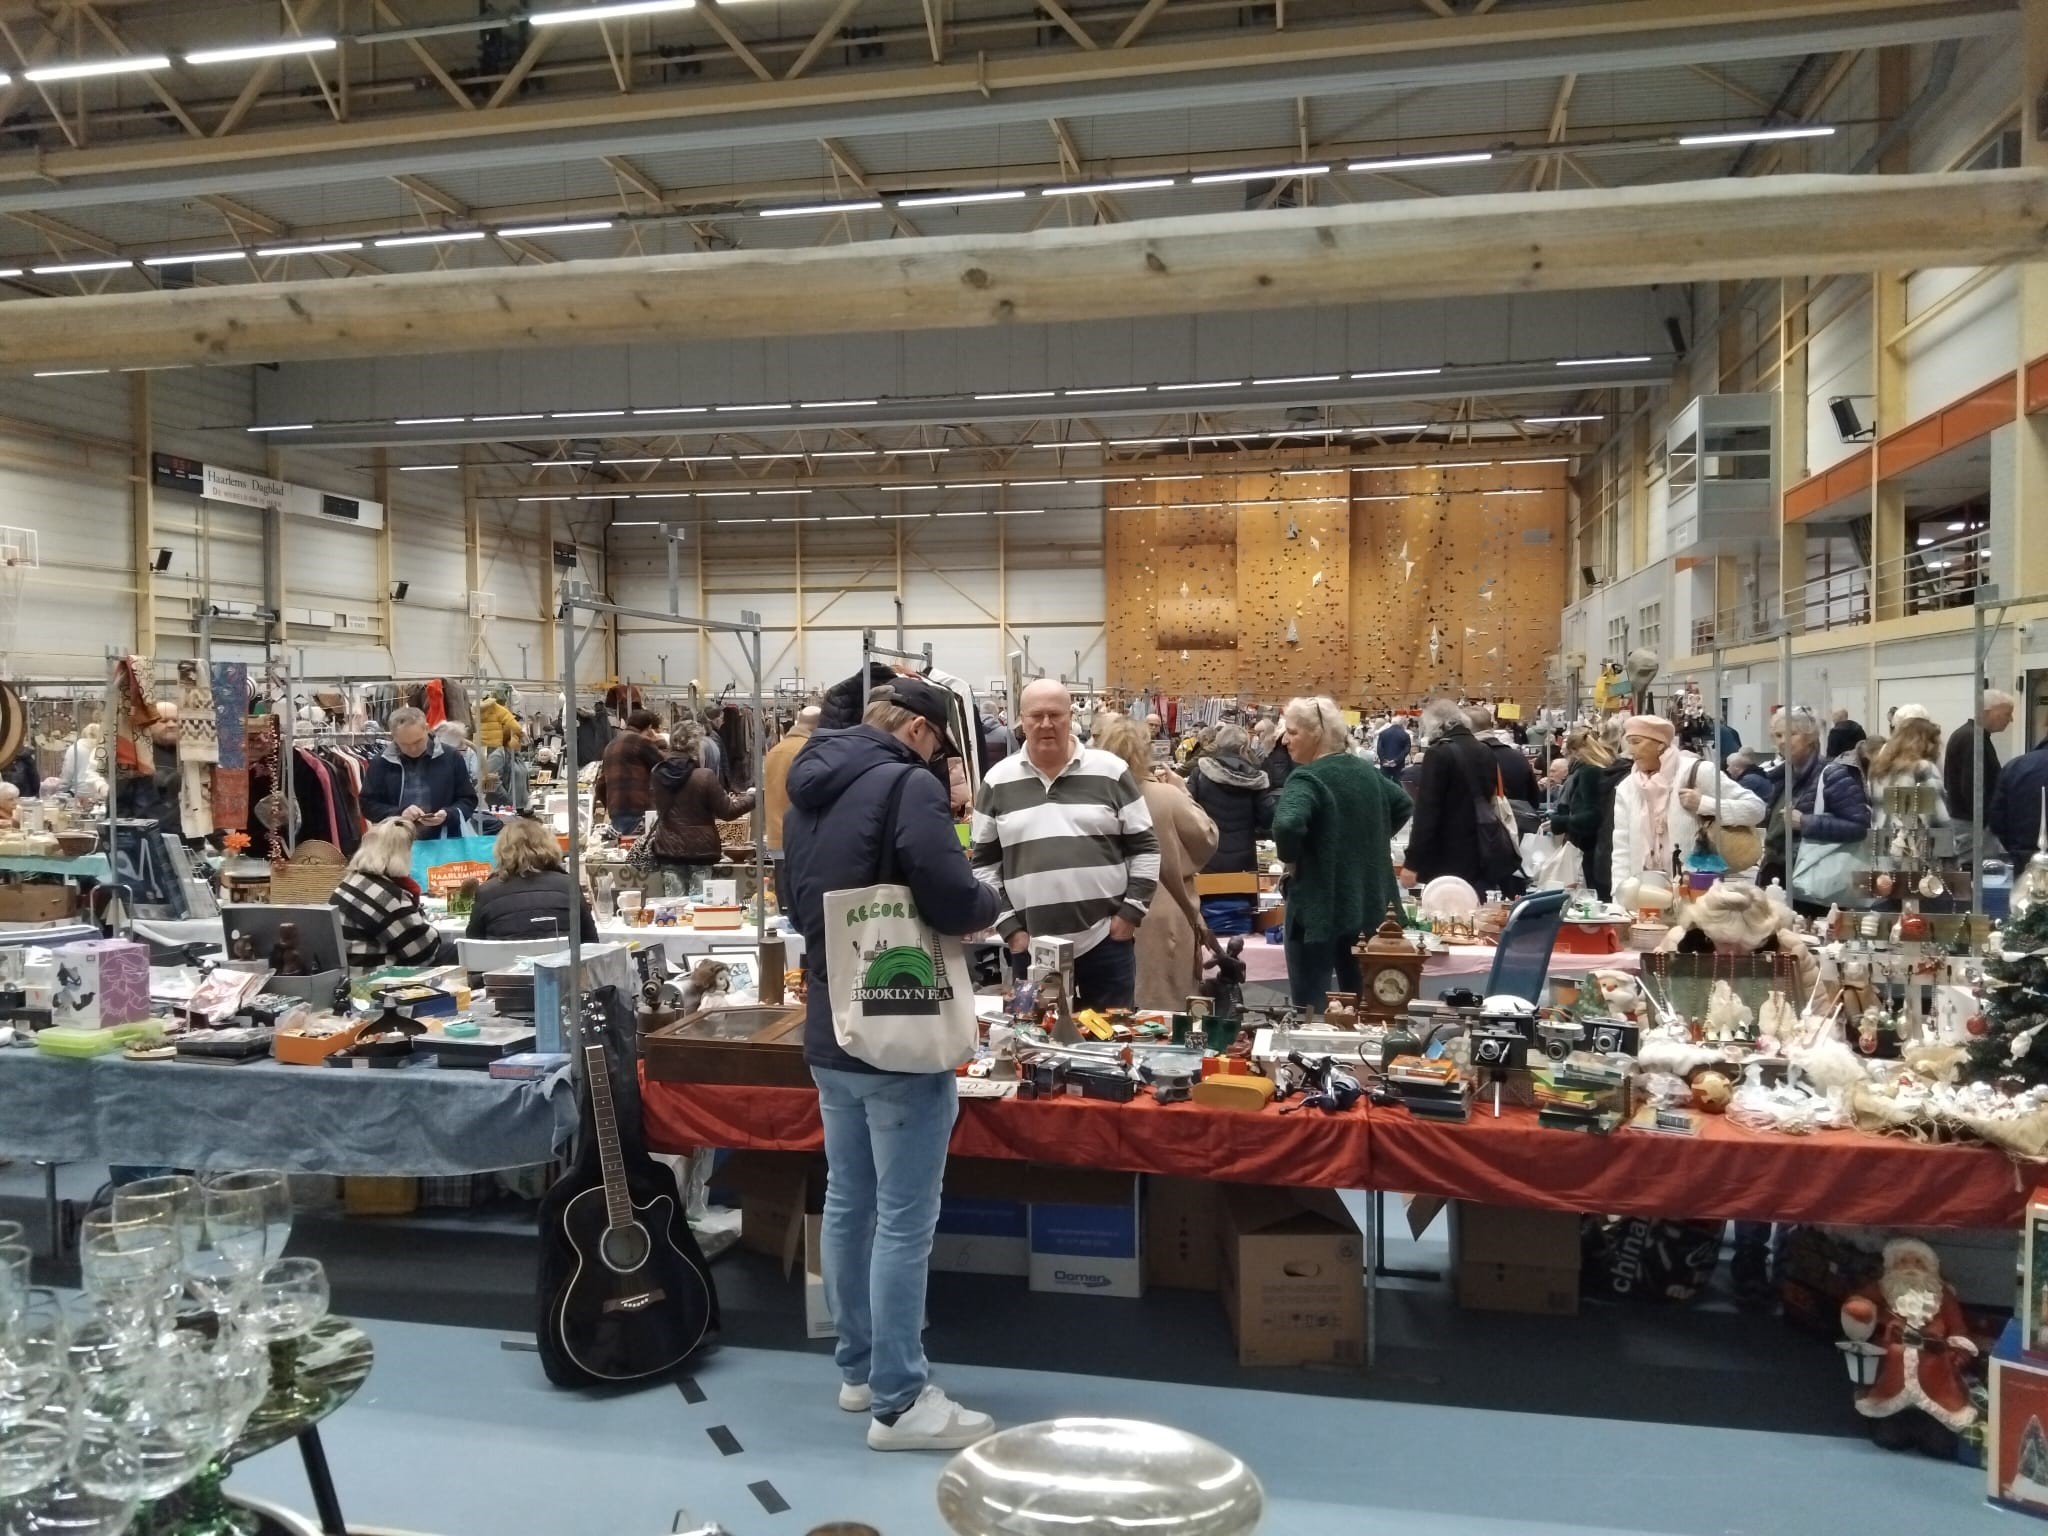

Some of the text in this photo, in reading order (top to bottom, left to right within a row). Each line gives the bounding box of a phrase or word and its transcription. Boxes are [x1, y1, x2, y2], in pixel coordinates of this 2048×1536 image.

[208, 470, 246, 488] Haarlems
[252, 479, 284, 496] Dagblad
[452, 864, 468, 872] WIJ
[851, 987, 925, 1000] BROOKLYN
[1610, 1221, 1648, 1292] china
